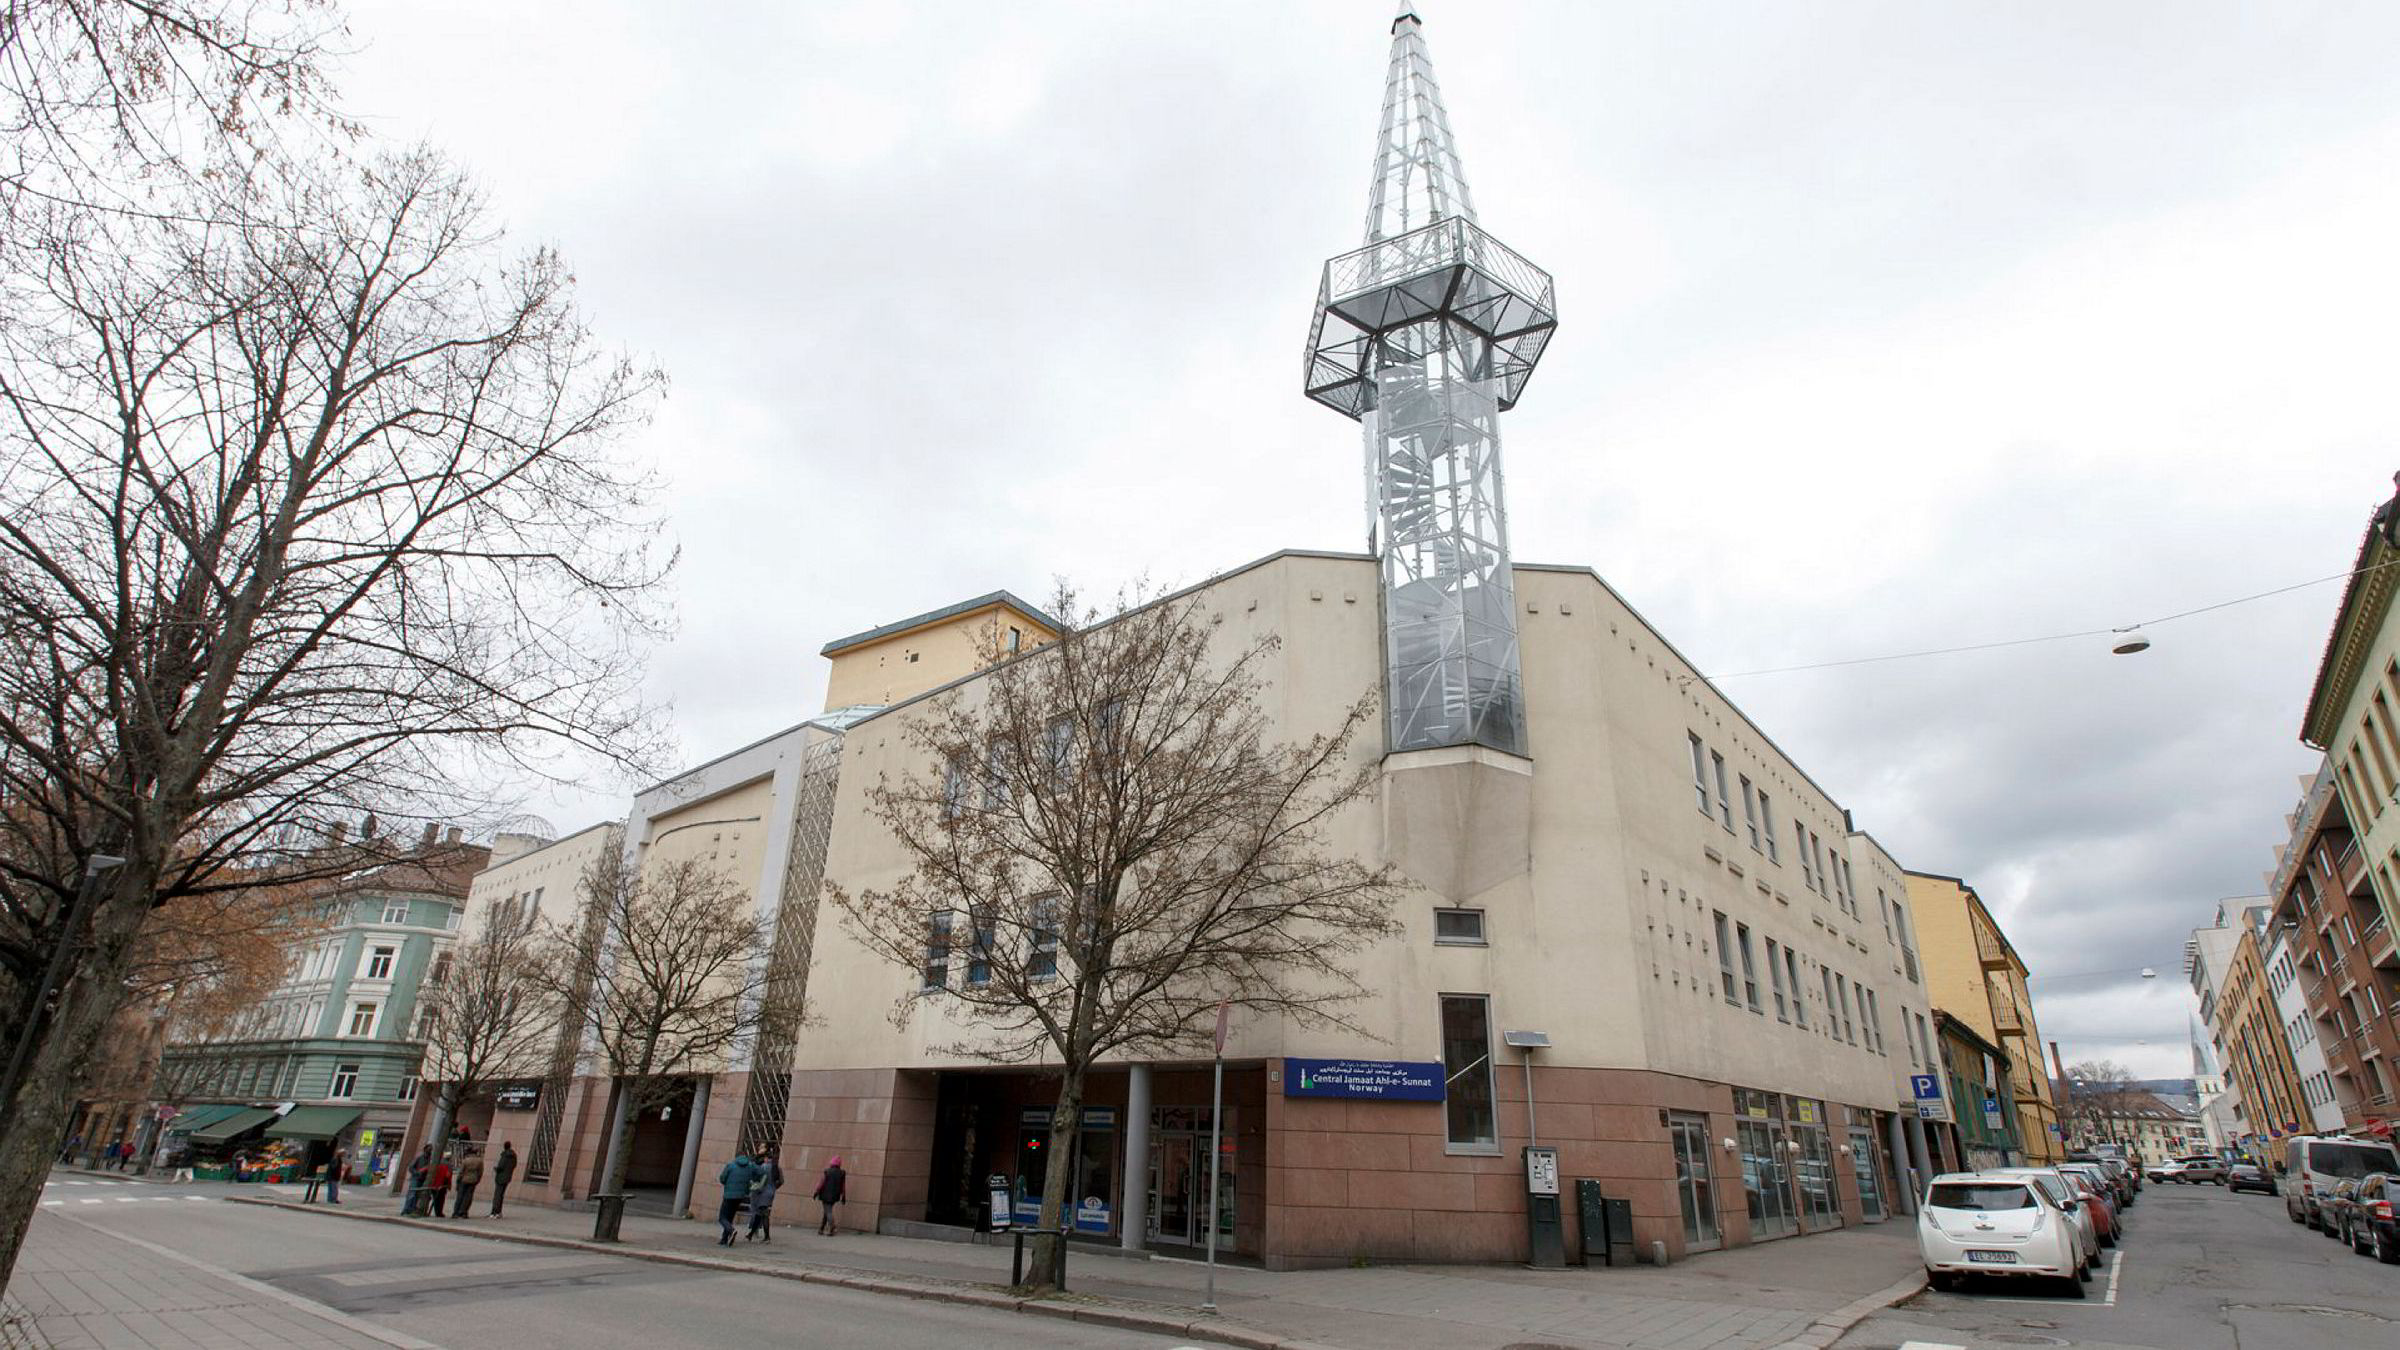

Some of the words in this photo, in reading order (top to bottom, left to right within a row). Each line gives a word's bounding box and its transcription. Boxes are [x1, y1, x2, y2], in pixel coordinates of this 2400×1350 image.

[1312, 1074, 1342, 1083] Central
[1344, 1075, 1374, 1085] Jamaat
[1402, 1077, 1431, 1087] Sunnat
[1348, 1084, 1383, 1094] Norway
[1917, 1078, 1931, 1096] P
[1986, 1100, 1994, 1111] P
